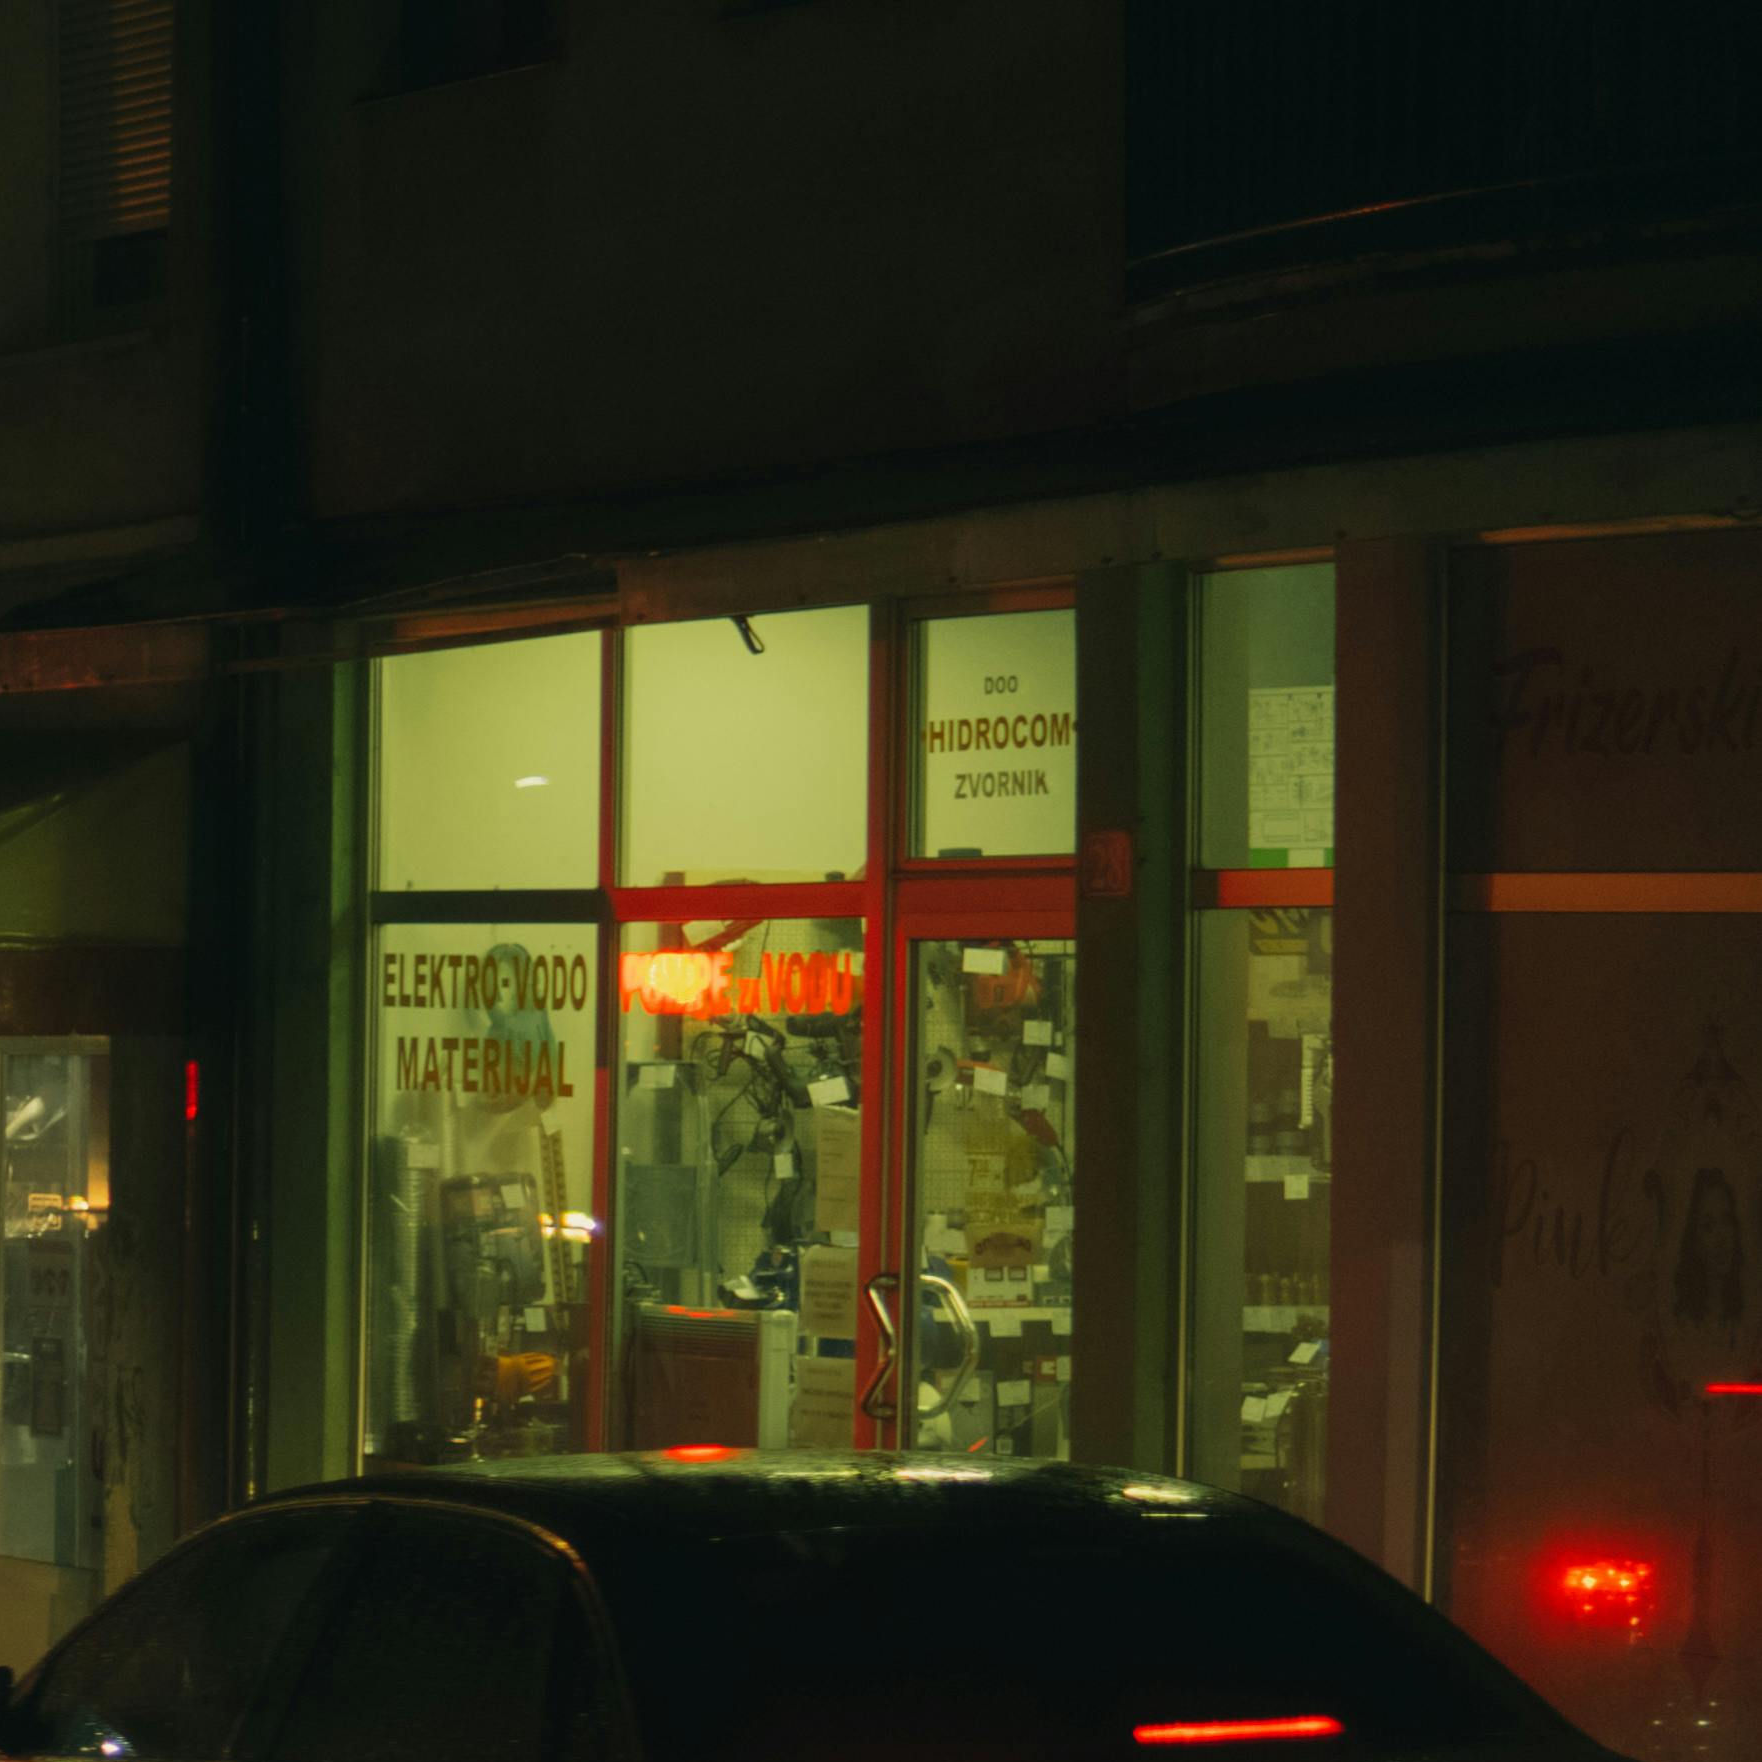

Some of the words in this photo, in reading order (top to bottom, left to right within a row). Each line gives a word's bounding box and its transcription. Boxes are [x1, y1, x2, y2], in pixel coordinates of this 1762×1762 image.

[984, 675, 1019, 695] DOO
[928, 713, 1071, 753] HIDROCOM
[954, 769, 1050, 800] ZVORNIK
[383, 953, 587, 1011] ELEKTRO-VODO
[764, 951, 853, 1014] VODU
[396, 1036, 573, 1098] MATERIJAL
